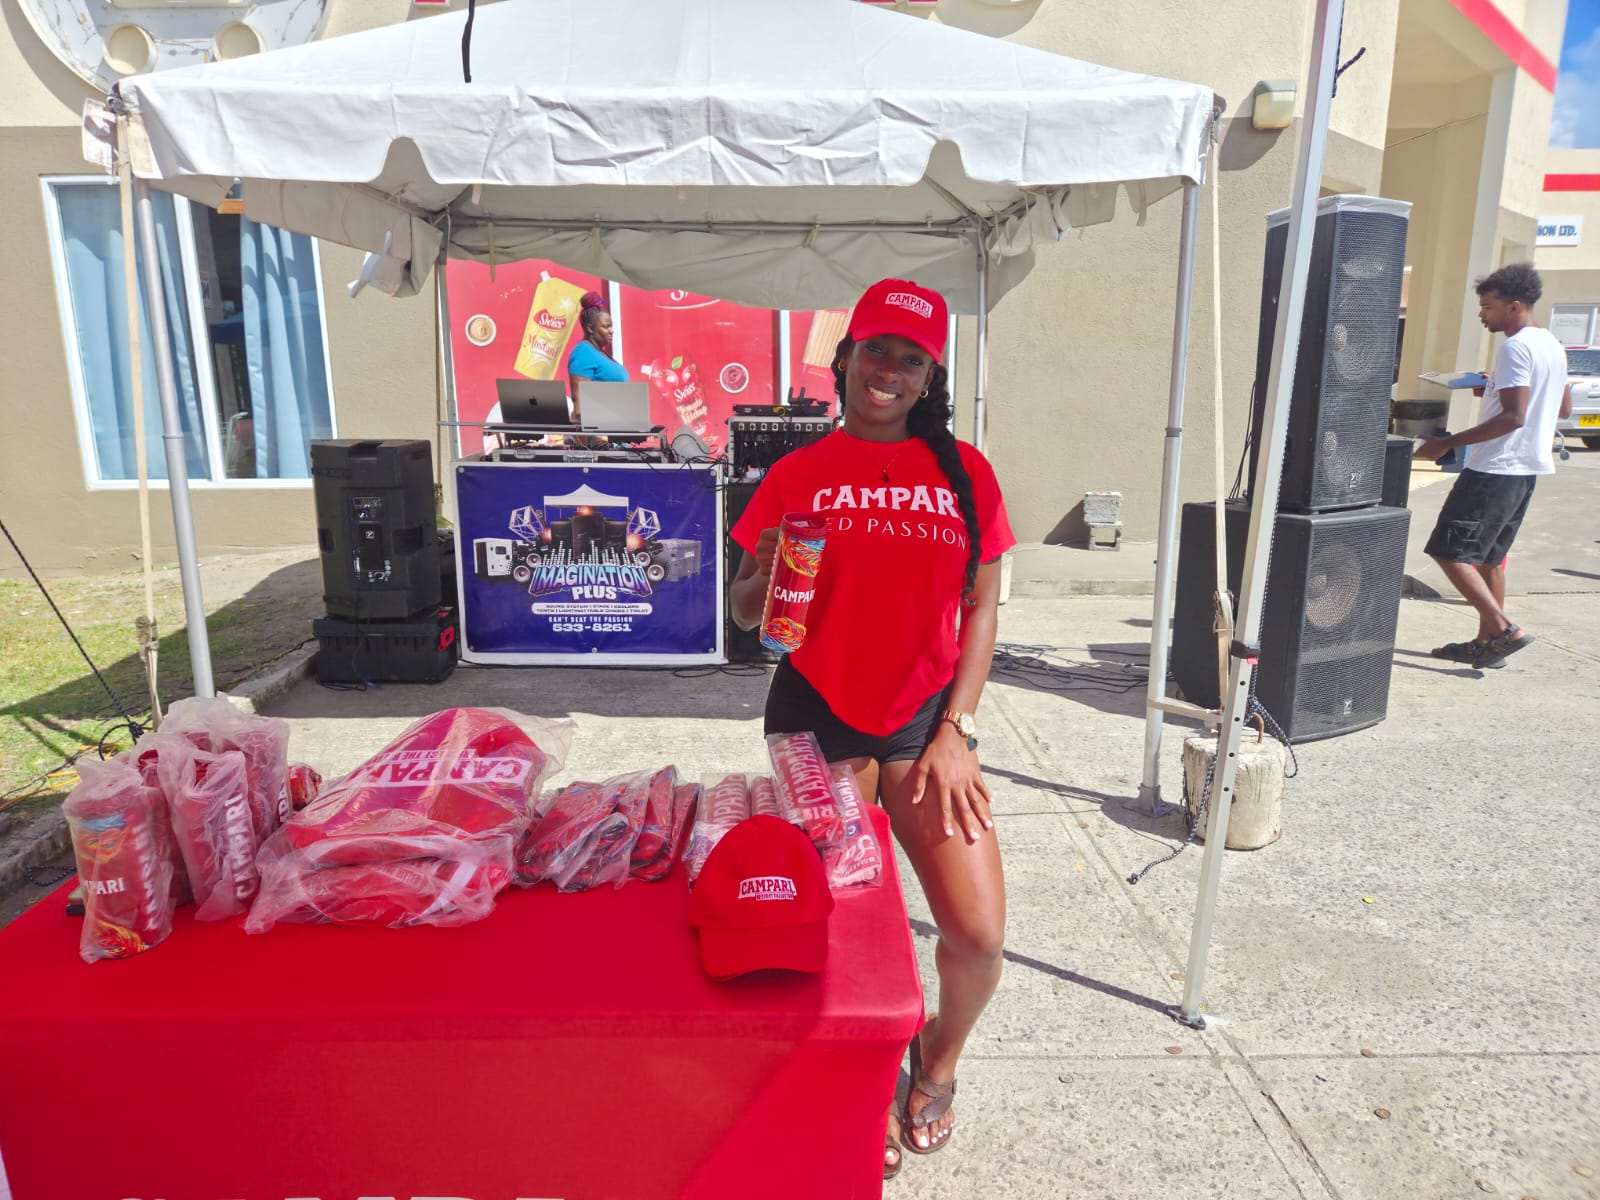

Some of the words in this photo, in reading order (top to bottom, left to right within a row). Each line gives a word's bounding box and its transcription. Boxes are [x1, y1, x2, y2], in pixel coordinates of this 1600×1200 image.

[1559, 225, 1577, 236] LTD.
[888, 294, 931, 313] CAMPARI
[826, 516, 853, 531] ED
[867, 518, 966, 551] PASSION
[530, 565, 652, 595] IMAGINATION
[572, 585, 617, 600] PLUS
[552, 623, 632, 632] 533-8261
[784, 739, 831, 804] CAMPARI
[741, 879, 793, 896] CAMPARI
